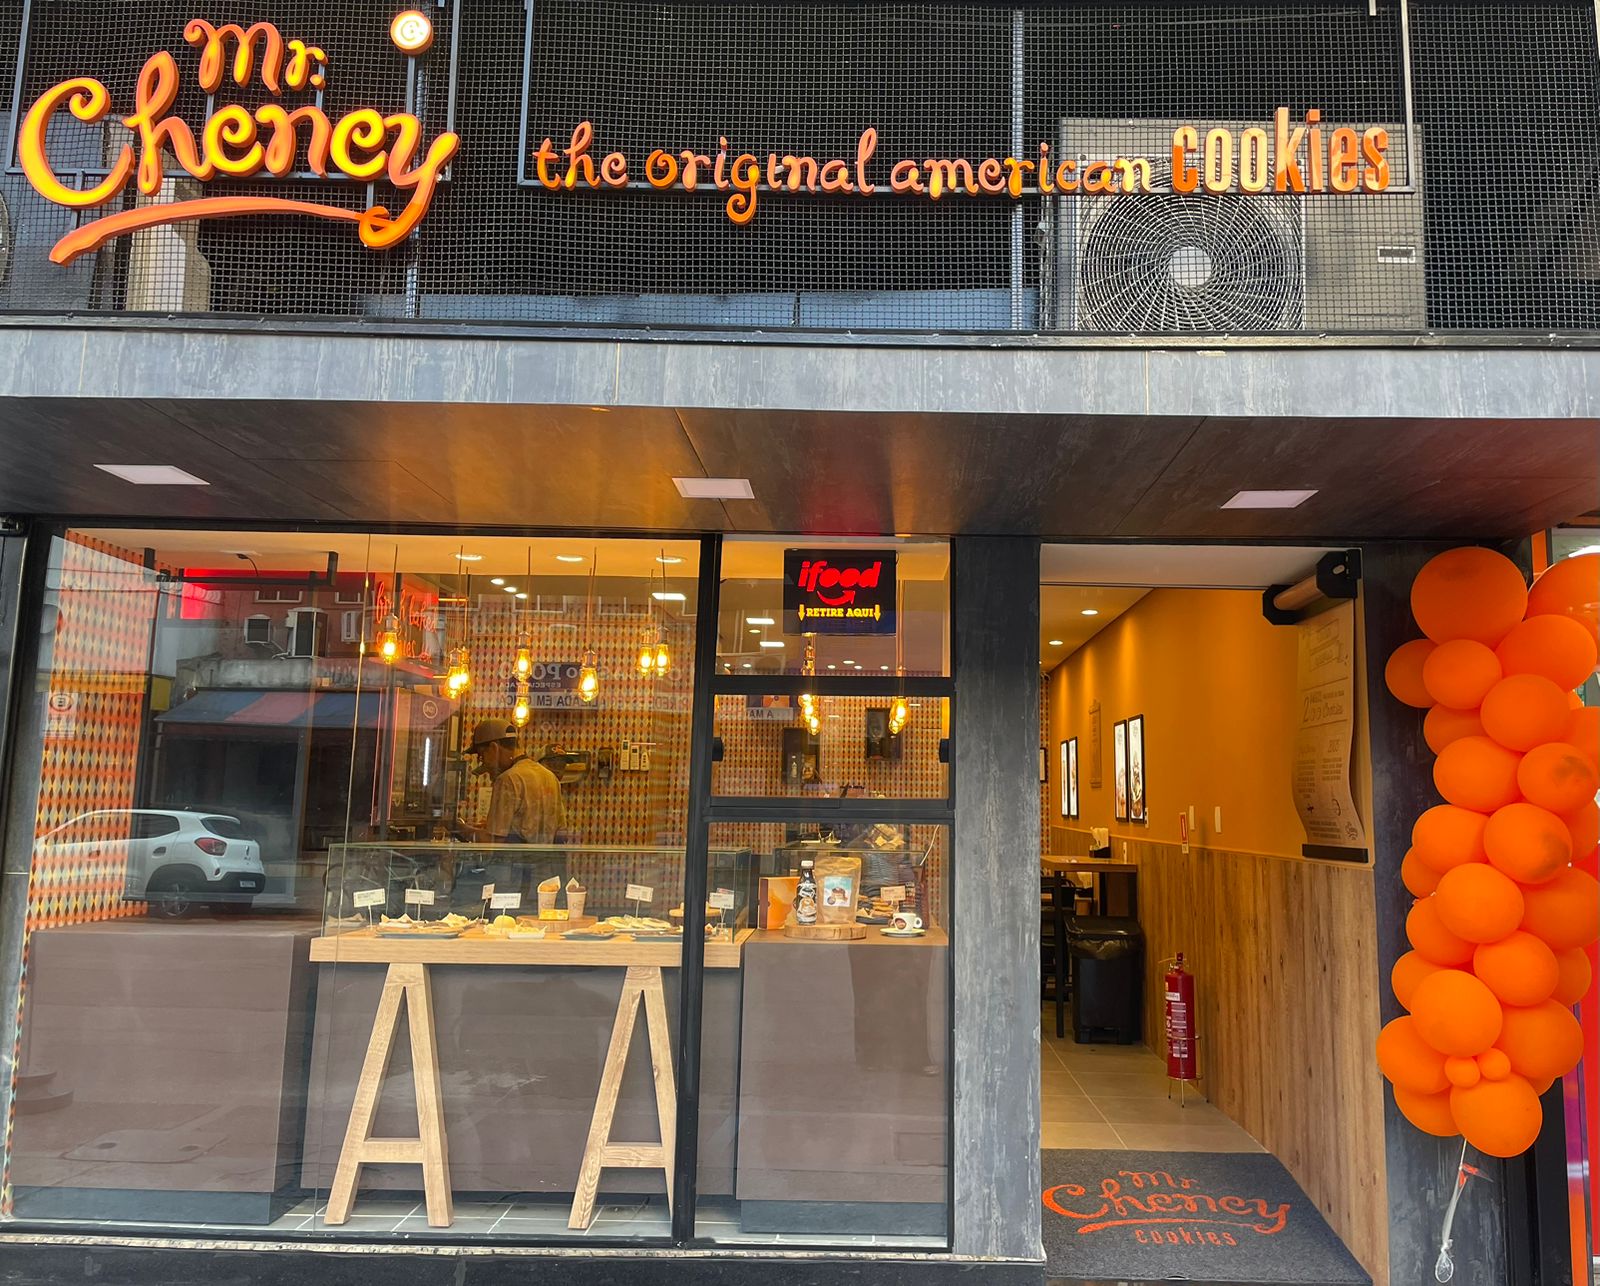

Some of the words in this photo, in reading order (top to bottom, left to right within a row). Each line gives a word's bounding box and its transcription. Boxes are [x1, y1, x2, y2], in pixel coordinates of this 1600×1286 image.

[18, 50, 460, 264] Cheney
[532, 120, 600, 190] the
[645, 127, 877, 226] original
[890, 141, 1151, 200] american
[1171, 106, 1391, 194] cookies
[805, 607, 845, 618] RETIRE
[845, 607, 874, 618] AQUI
[1041, 1178, 1292, 1236] Cheney
[1135, 1227, 1238, 1247] cookies
